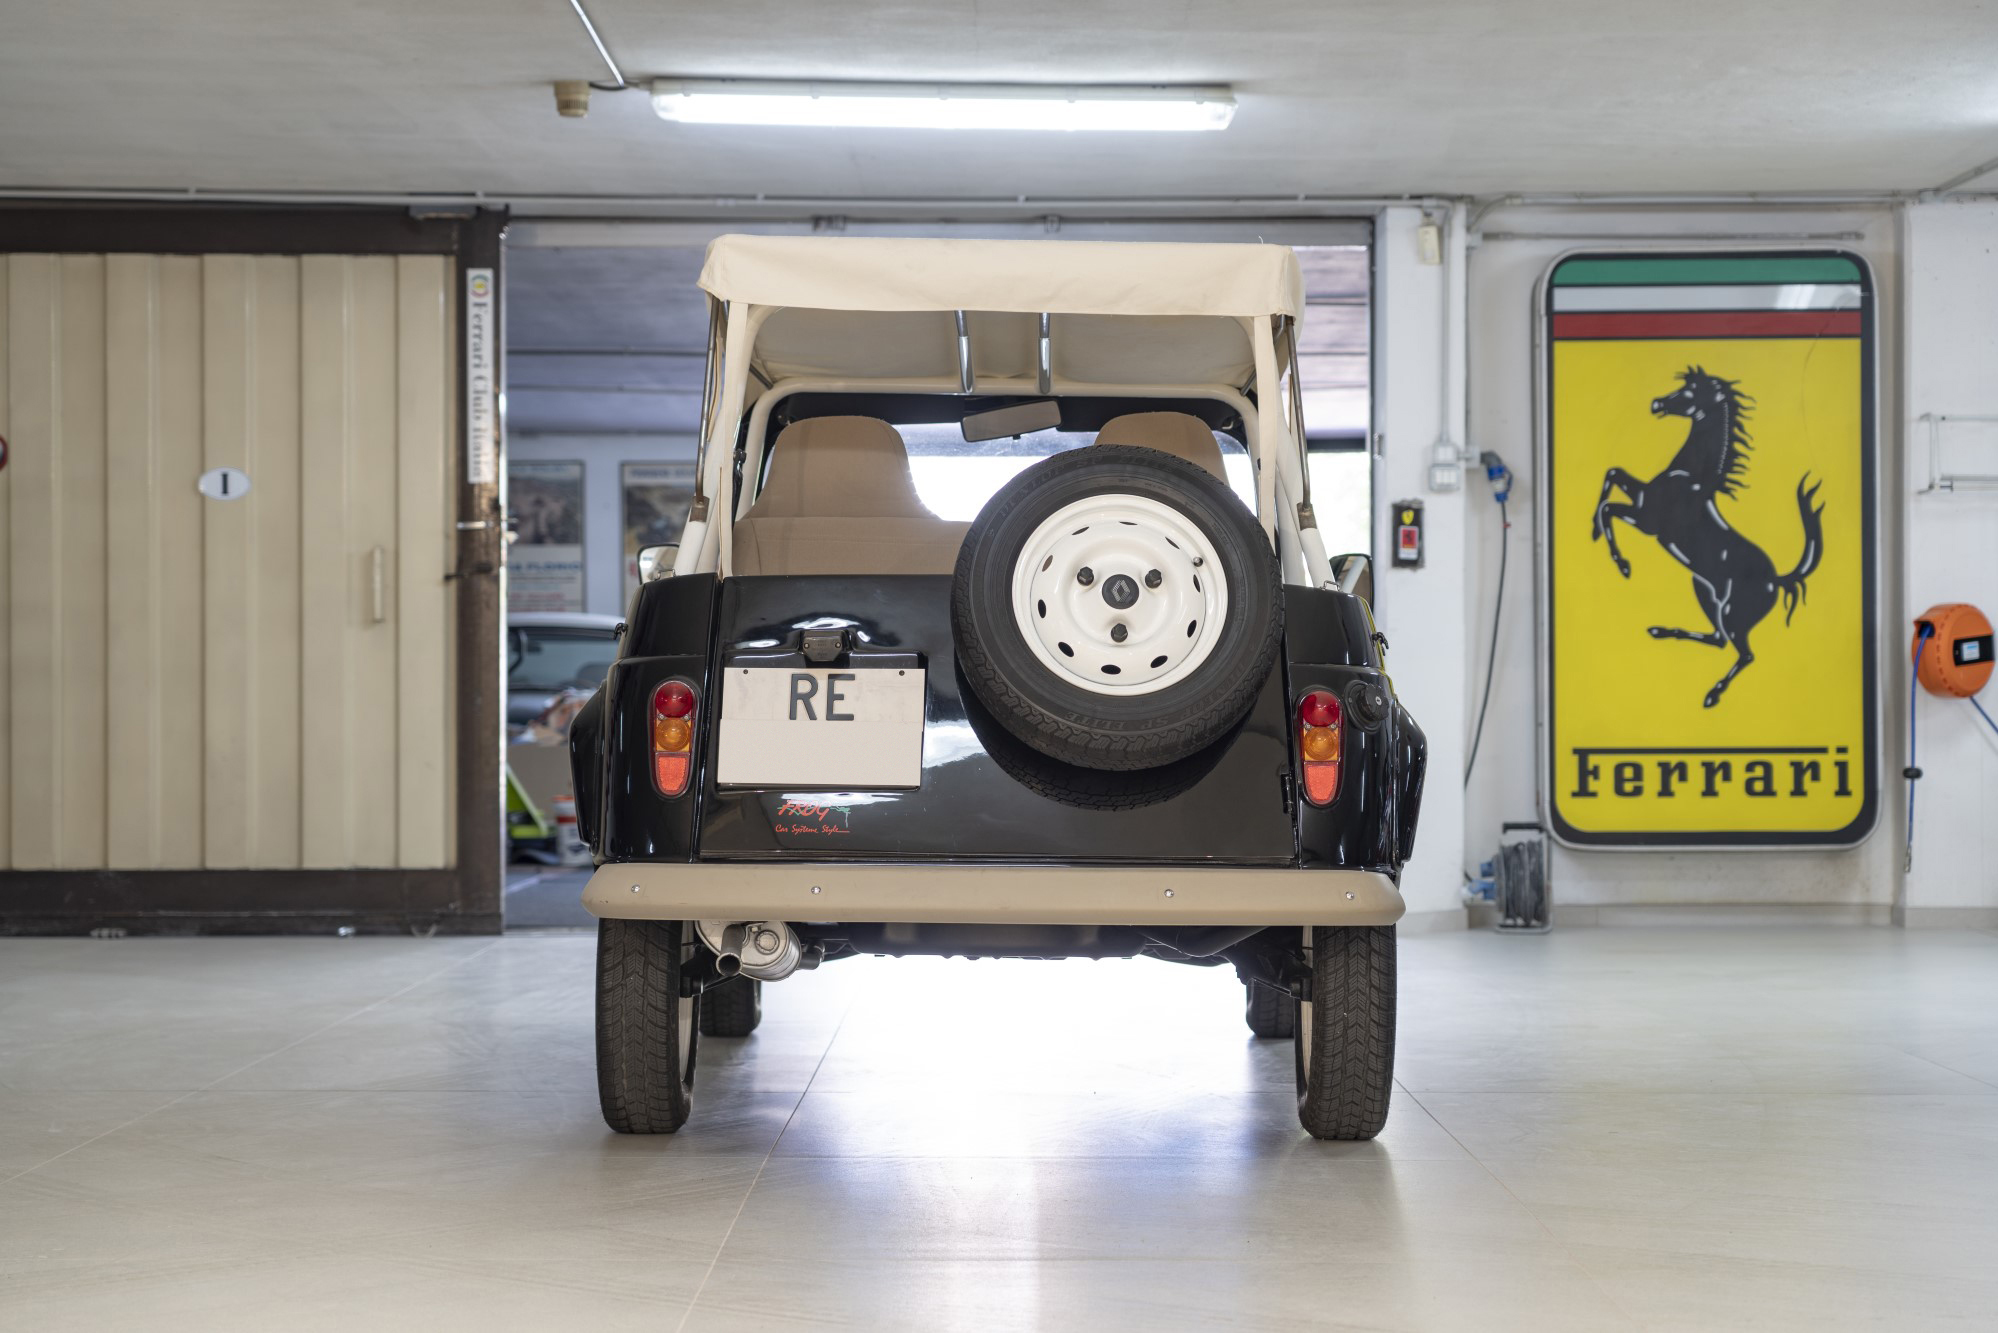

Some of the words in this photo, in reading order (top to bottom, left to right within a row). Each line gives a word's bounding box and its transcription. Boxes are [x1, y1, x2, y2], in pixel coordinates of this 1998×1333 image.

[472, 302, 488, 369] Ferrari
[472, 375, 488, 421] Club
[789, 673, 856, 721] RE
[1065, 711, 1126, 731] ELITE
[1570, 746, 1852, 798] Ferrari
[775, 824, 788, 833] Car
[822, 824, 840, 836] Style
